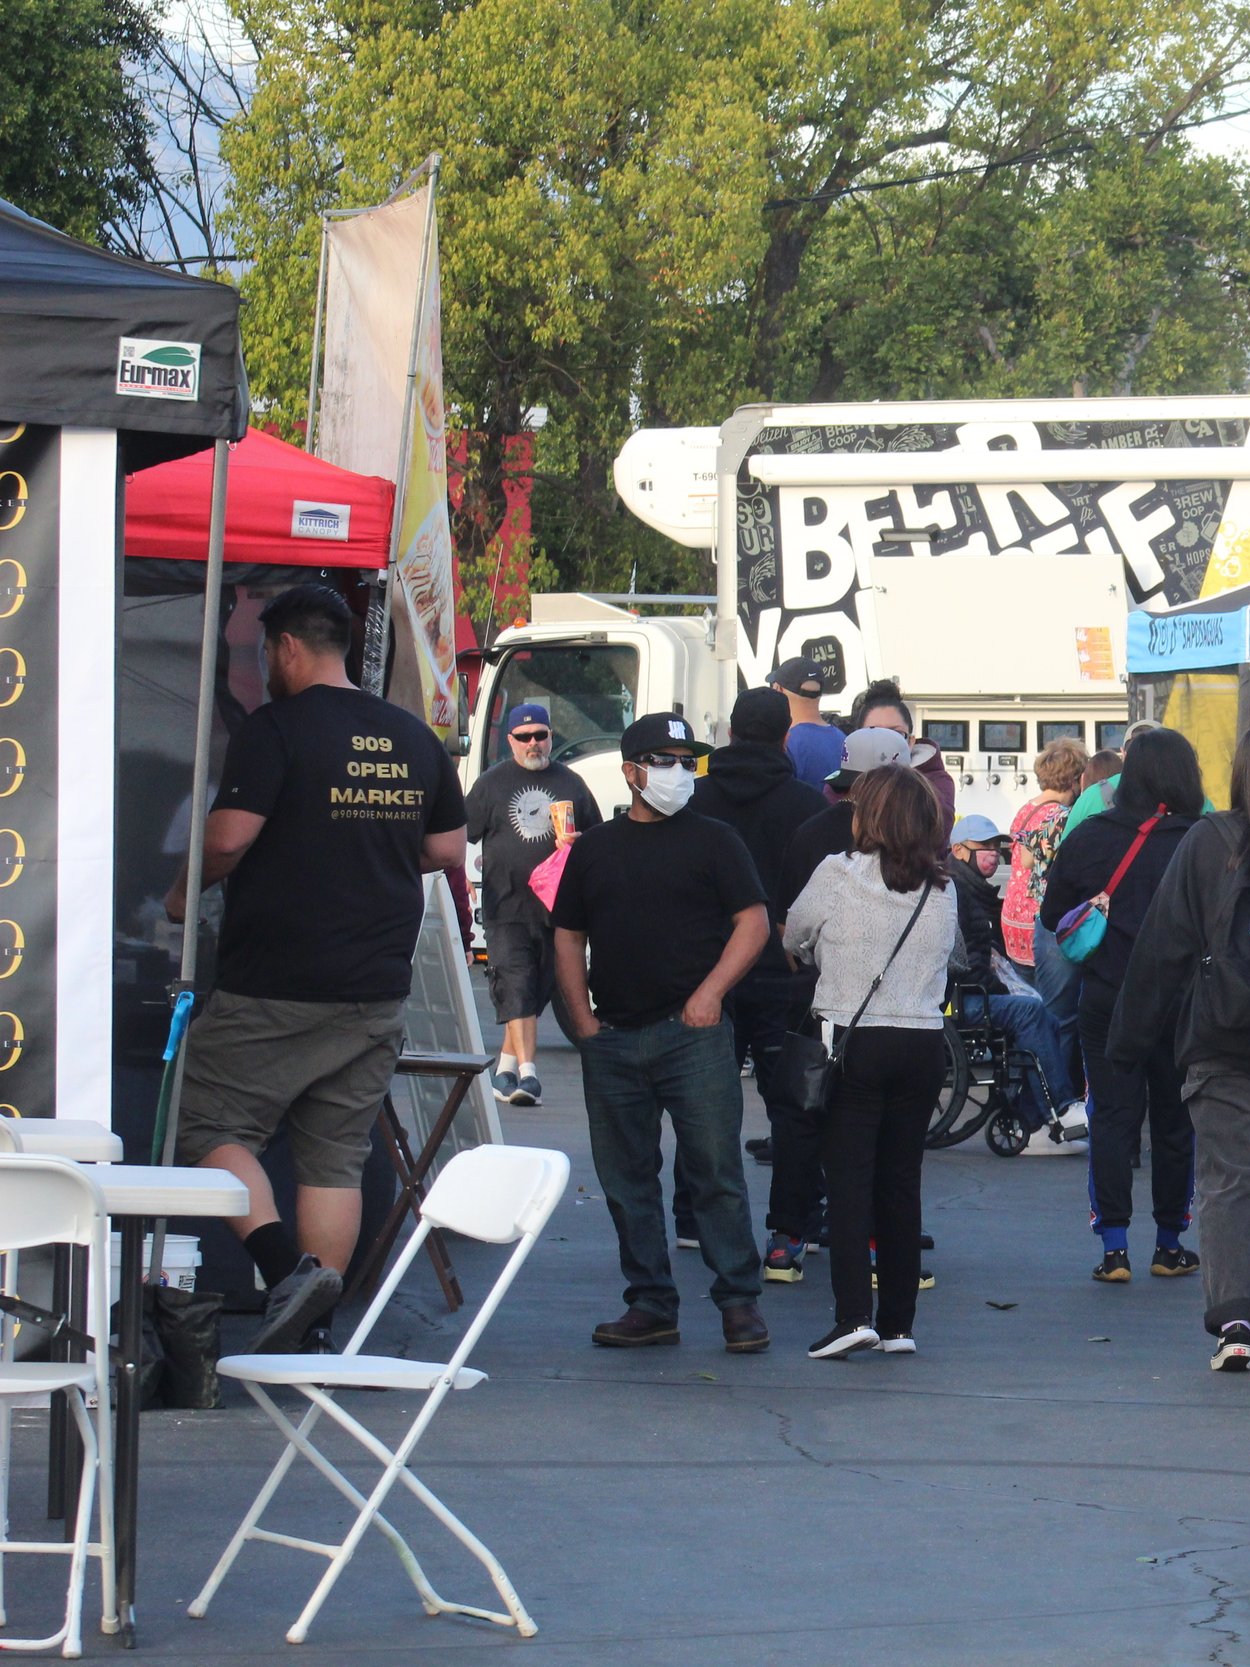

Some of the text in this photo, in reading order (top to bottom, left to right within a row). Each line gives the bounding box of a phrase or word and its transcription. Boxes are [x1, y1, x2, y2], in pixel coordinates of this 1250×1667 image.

[119, 360, 191, 389] Eurmax
[828, 432, 858, 448] COOP
[1101, 430, 1143, 449] AMBER
[298, 516, 339, 529] KITTRICH
[298, 526, 339, 536] CANOPY
[351, 735, 393, 753] 909
[347, 761, 409, 779] OPEN
[330, 787, 425, 806] MARKET
